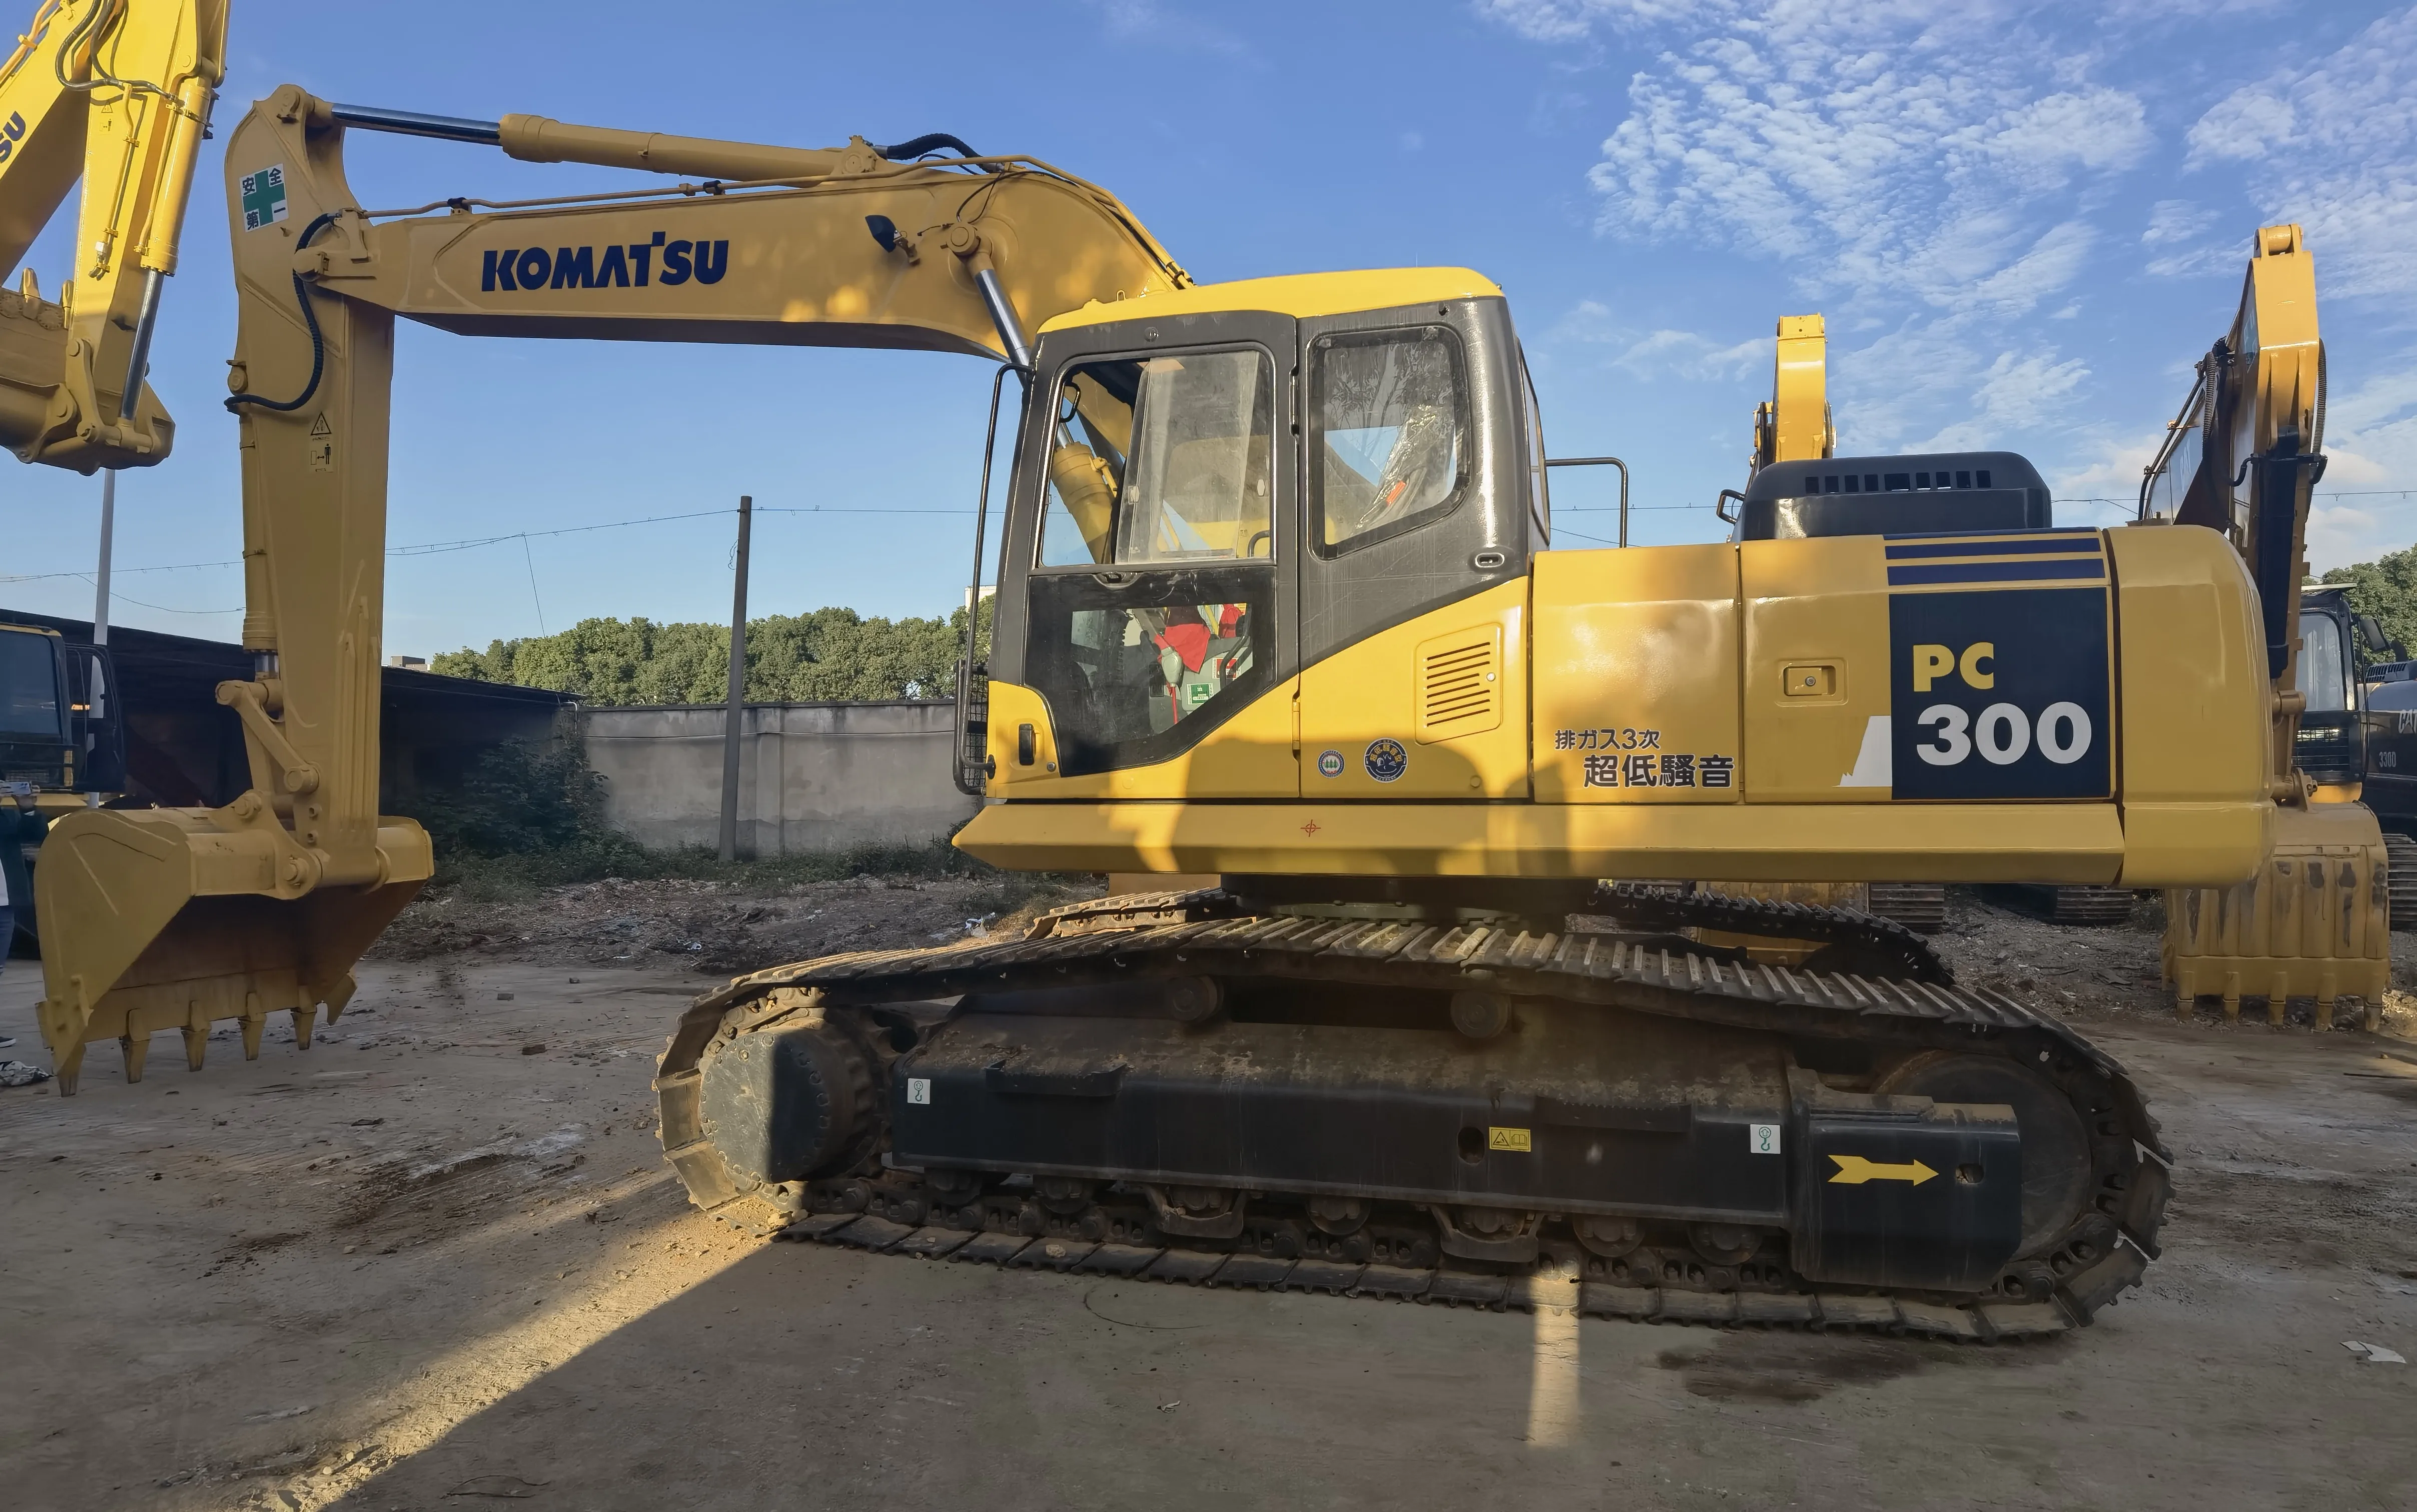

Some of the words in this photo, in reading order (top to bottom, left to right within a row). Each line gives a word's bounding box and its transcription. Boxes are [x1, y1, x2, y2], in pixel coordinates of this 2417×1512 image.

[481, 231, 728, 292] KOMATSU
[1913, 642, 1994, 692] PC
[1554, 728, 1661, 750] 排ガス3次
[1917, 701, 2092, 766] 300
[1583, 754, 1734, 788] 超低騒音
